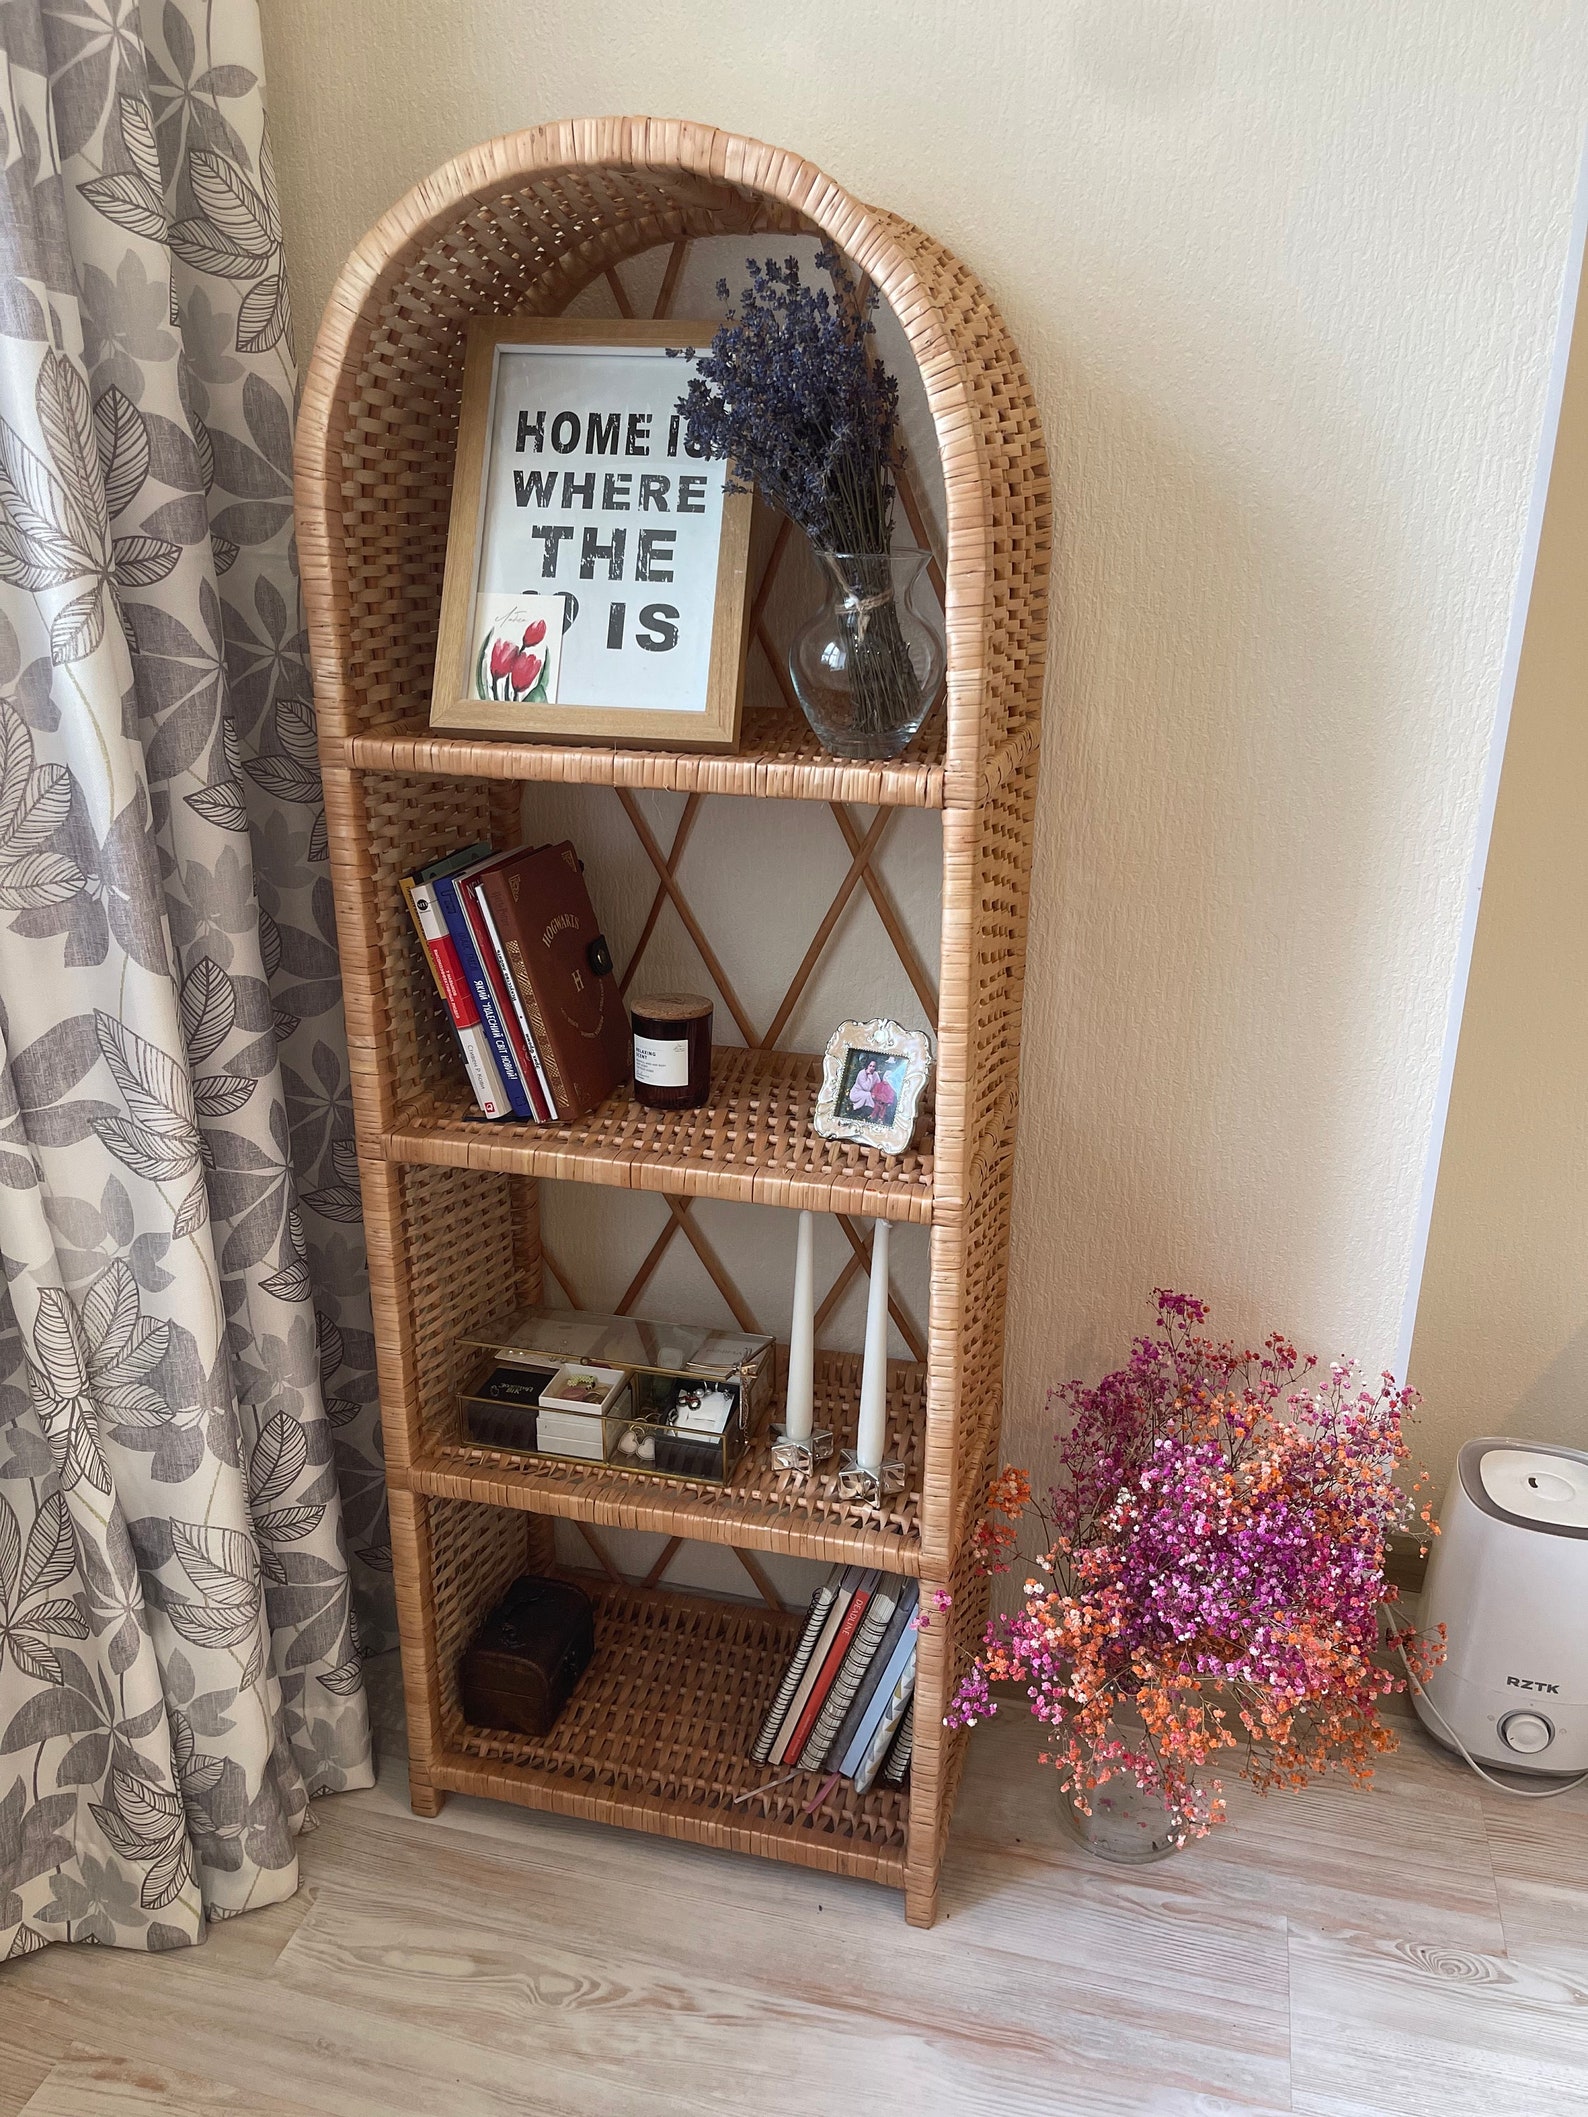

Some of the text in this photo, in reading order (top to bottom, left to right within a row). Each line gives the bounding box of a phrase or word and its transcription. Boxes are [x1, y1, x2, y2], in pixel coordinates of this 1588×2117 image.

[515, 411, 652, 456] HOME
[513, 470, 708, 513] WHERE
[531, 525, 677, 583] THE
[606, 602, 681, 652] IS
[542, 914, 580, 949] HOGWARTS
[474, 980, 518, 1080] ЯКИЙ ЧУДЕСНИЙ СВІТ НОВИЙ!
[842, 1598, 864, 1636] DEADLINE
[1506, 1676, 1560, 1694] RZTK
